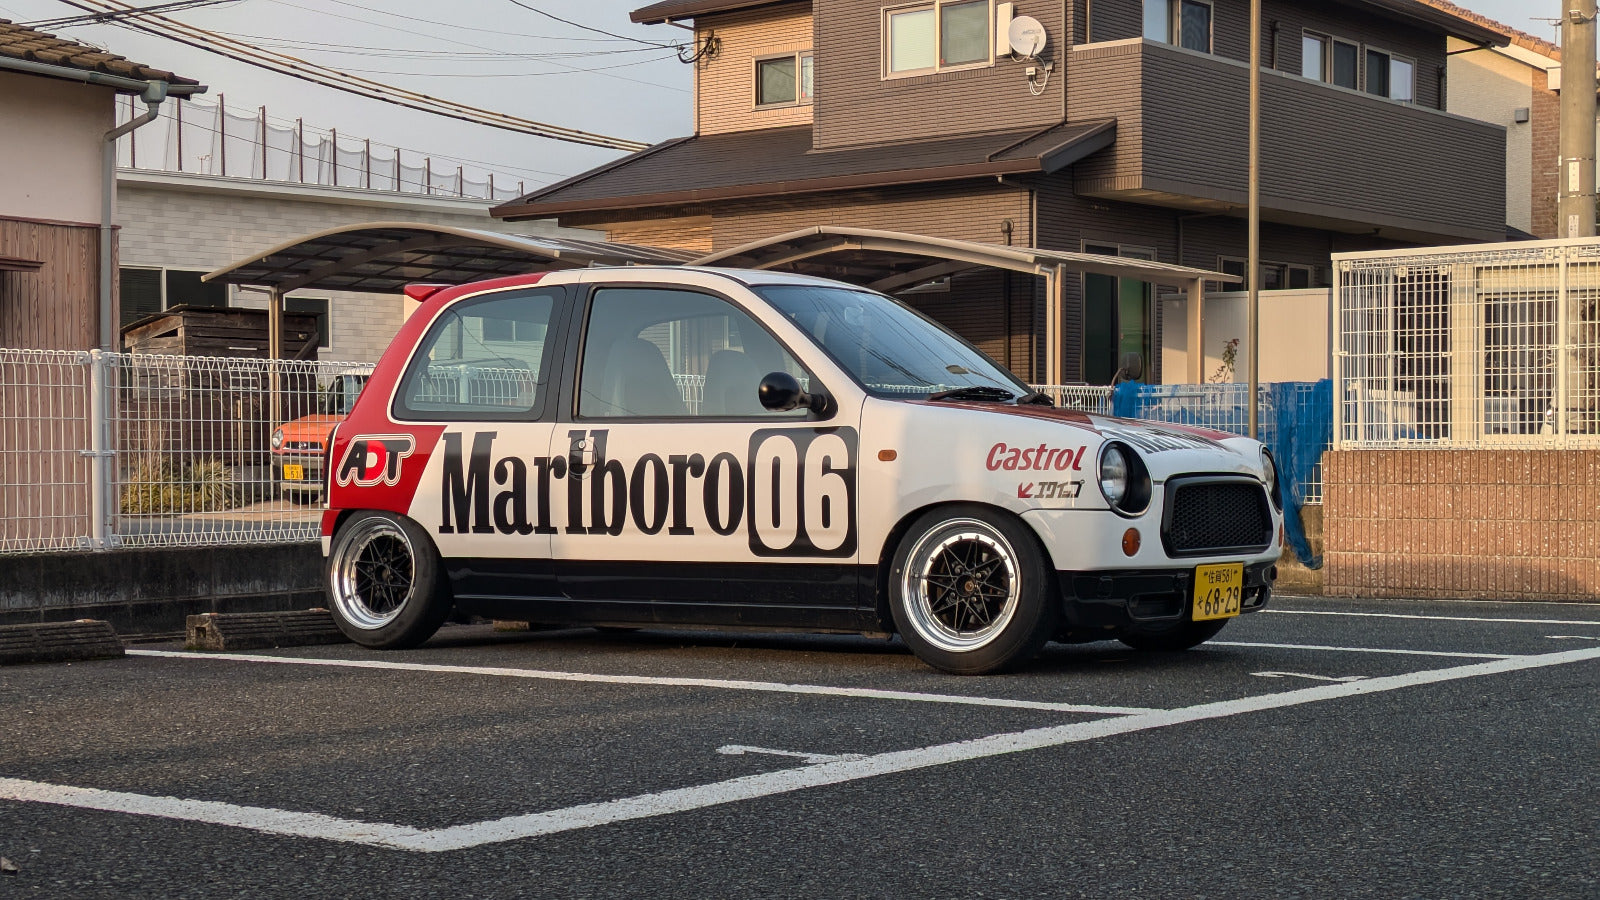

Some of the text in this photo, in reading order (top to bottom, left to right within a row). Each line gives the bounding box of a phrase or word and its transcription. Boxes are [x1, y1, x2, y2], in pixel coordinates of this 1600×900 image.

[337, 435, 414, 485] ADT
[438, 429, 745, 537] Marlboro
[754, 433, 849, 551] 06
[985, 442, 1088, 472] Castrol
